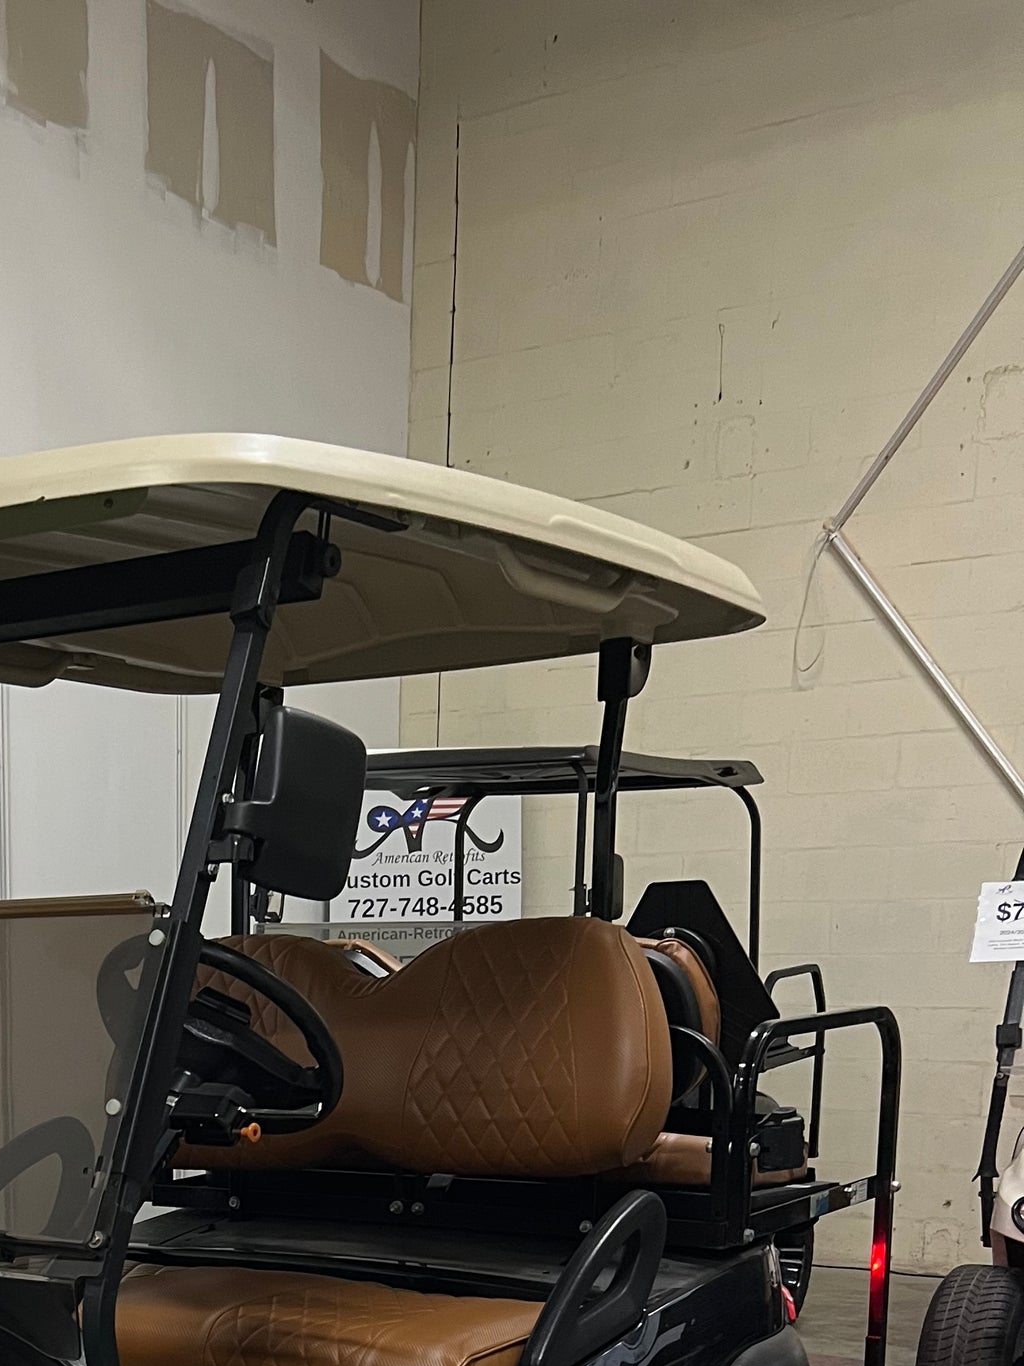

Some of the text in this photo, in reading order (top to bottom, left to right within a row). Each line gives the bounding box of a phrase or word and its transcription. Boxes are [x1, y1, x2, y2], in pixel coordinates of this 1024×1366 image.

[372, 848, 486, 866] American Retfits
[347, 869, 521, 889] ustom Gol Carts
[338, 927, 454, 941] American-Retro
